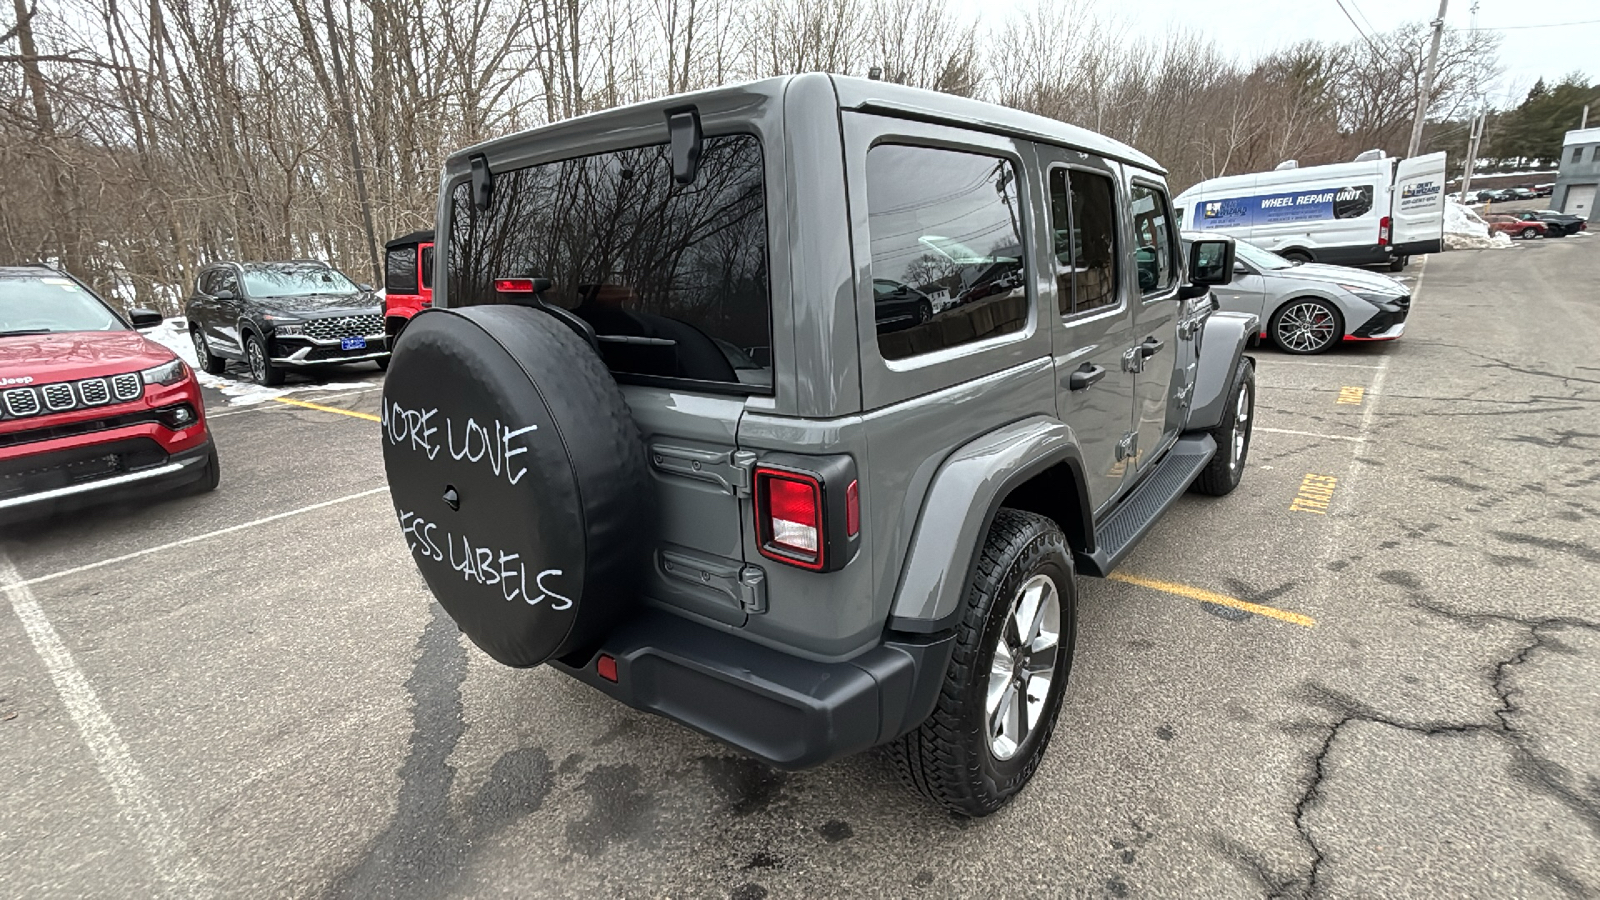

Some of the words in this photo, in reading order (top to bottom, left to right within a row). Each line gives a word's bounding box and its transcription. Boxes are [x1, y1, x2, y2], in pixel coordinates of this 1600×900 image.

[1261, 197, 1293, 209] WHEEL
[1297, 193, 1334, 205] REPAIR
[1336, 190, 1362, 202] UNIT
[0, 376, 33, 385] Jeep
[381, 396, 440, 461] MORE
[446, 417, 538, 485] LOVE
[1289, 473, 1338, 515] TRADES
[400, 509, 443, 562] ESS
[447, 532, 573, 611] LABELS
